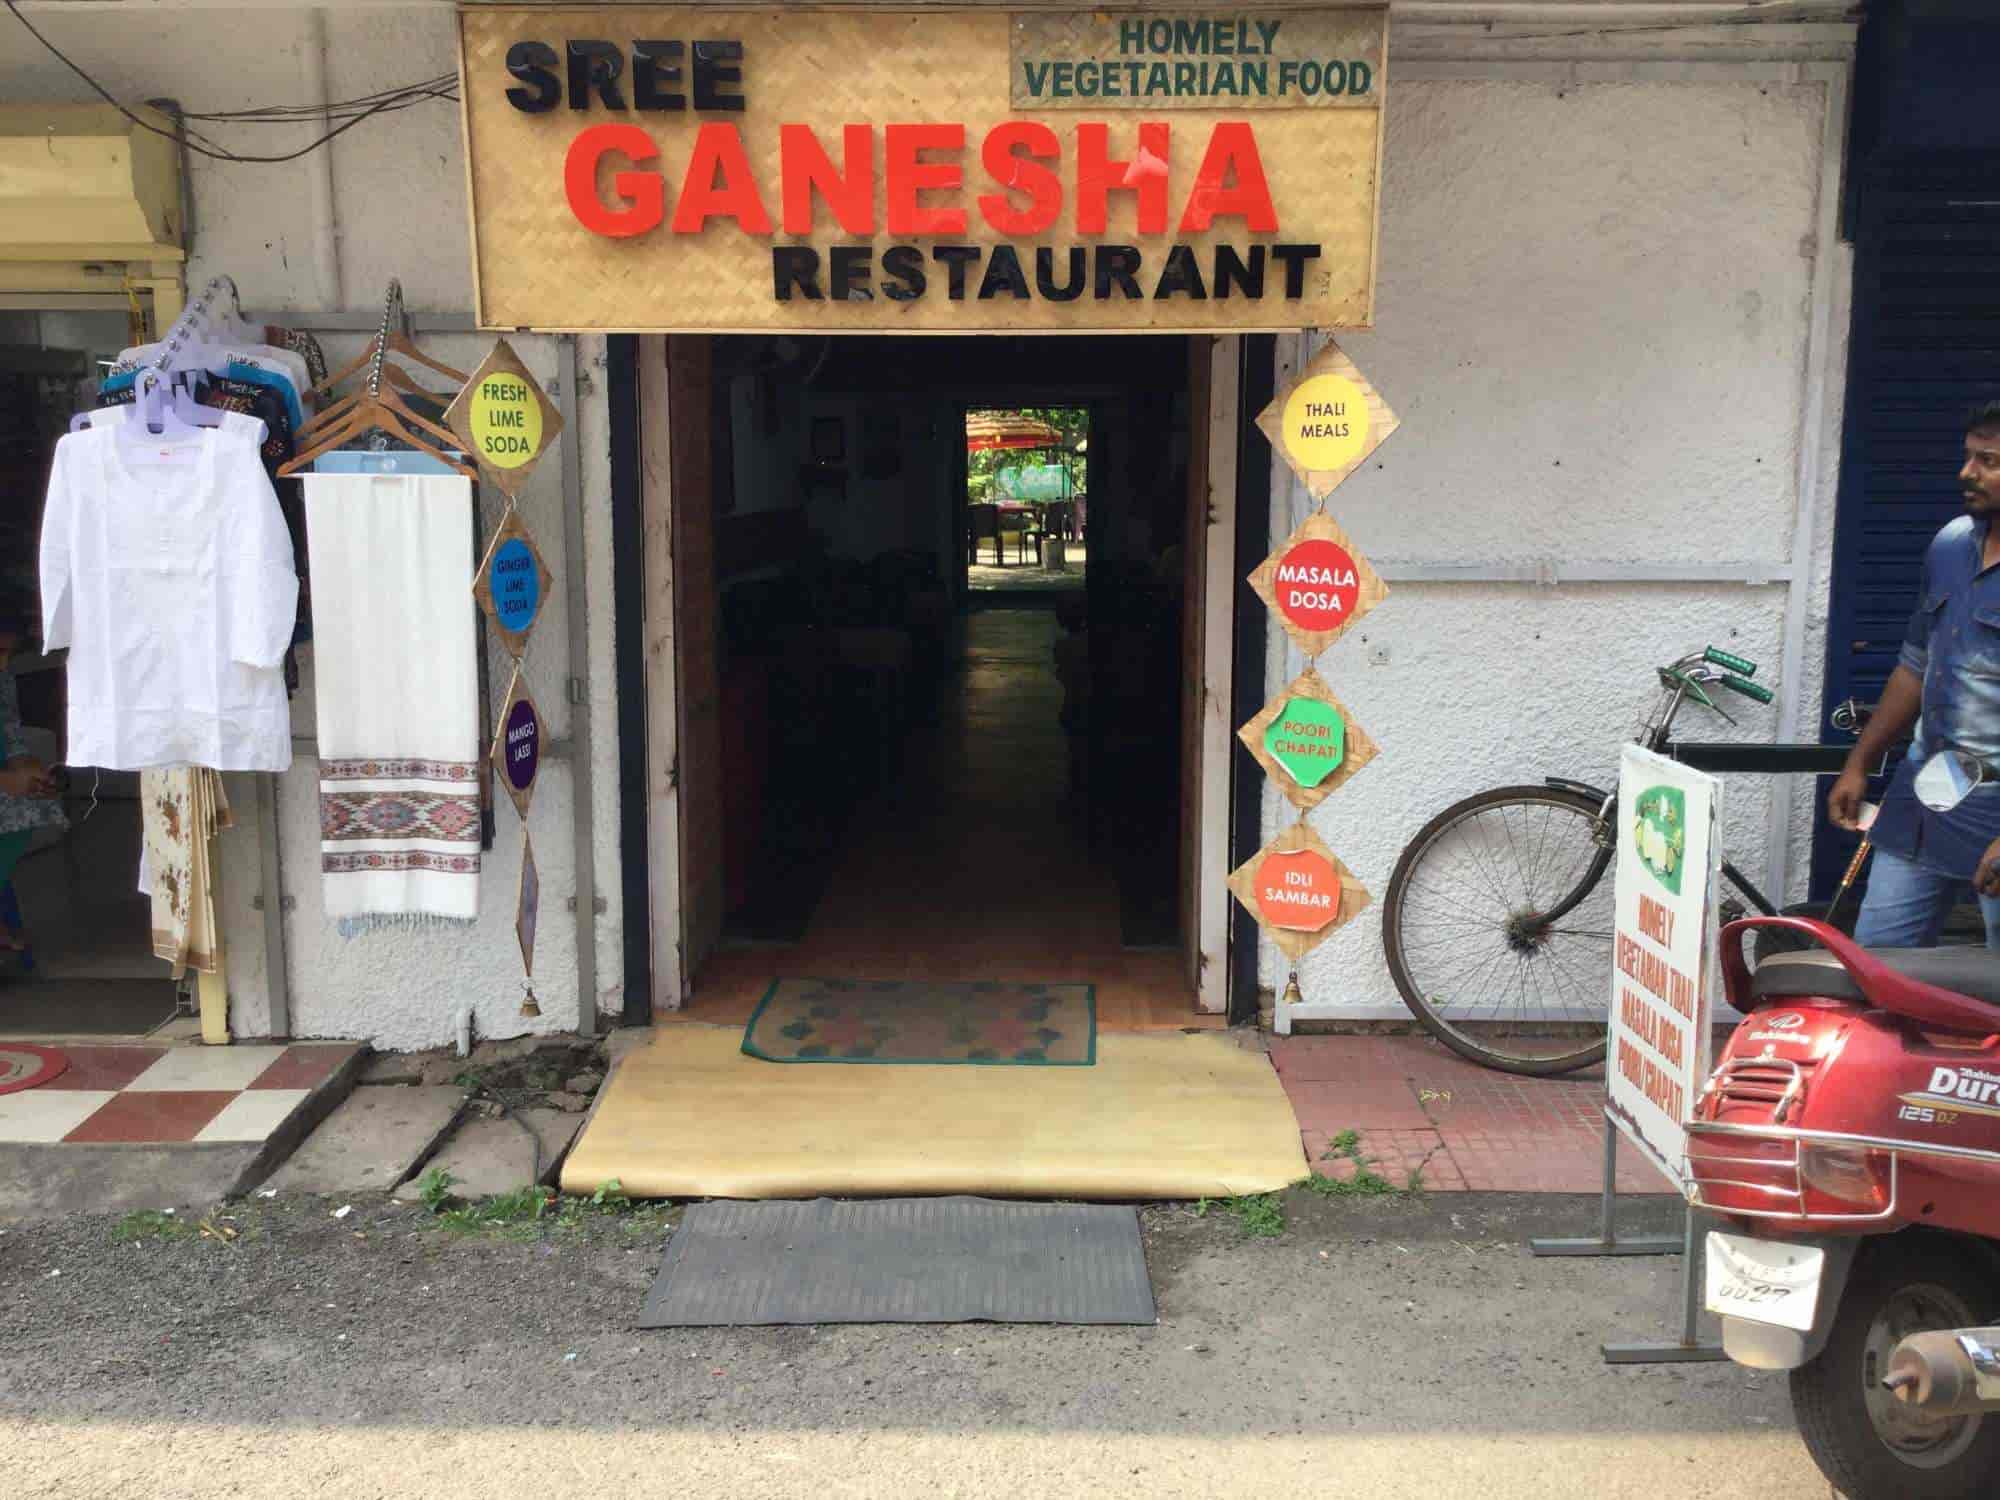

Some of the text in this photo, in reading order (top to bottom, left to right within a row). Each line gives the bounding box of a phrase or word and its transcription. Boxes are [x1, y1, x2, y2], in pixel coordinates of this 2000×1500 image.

[1119, 19, 1281, 54] HOMELY
[505, 39, 746, 112] SREE
[1023, 60, 1373, 97] VEGETARIAN FOOD
[564, 120, 1279, 238] GANESHA
[772, 243, 1321, 301] RESTAURANT
[483, 383, 528, 402] FRESH
[490, 410, 524, 427] LIME
[1305, 403, 1345, 417] THALI
[1300, 423, 1350, 438] MEALS
[485, 435, 531, 454] SODA
[1278, 565, 1356, 588] MASALA
[1289, 590, 1343, 611] DOSA
[509, 721, 535, 744] MANGO
[1284, 720, 1331, 738] POORI
[514, 743, 531, 762] LASSI
[1274, 738, 1338, 759] CHAPATI
[1284, 870, 1313, 887] IDLI
[1264, 887, 1332, 909] SAMBAR
[1621, 986, 1657, 1048] MASALA
[1898, 1106, 1935, 1122] 125
